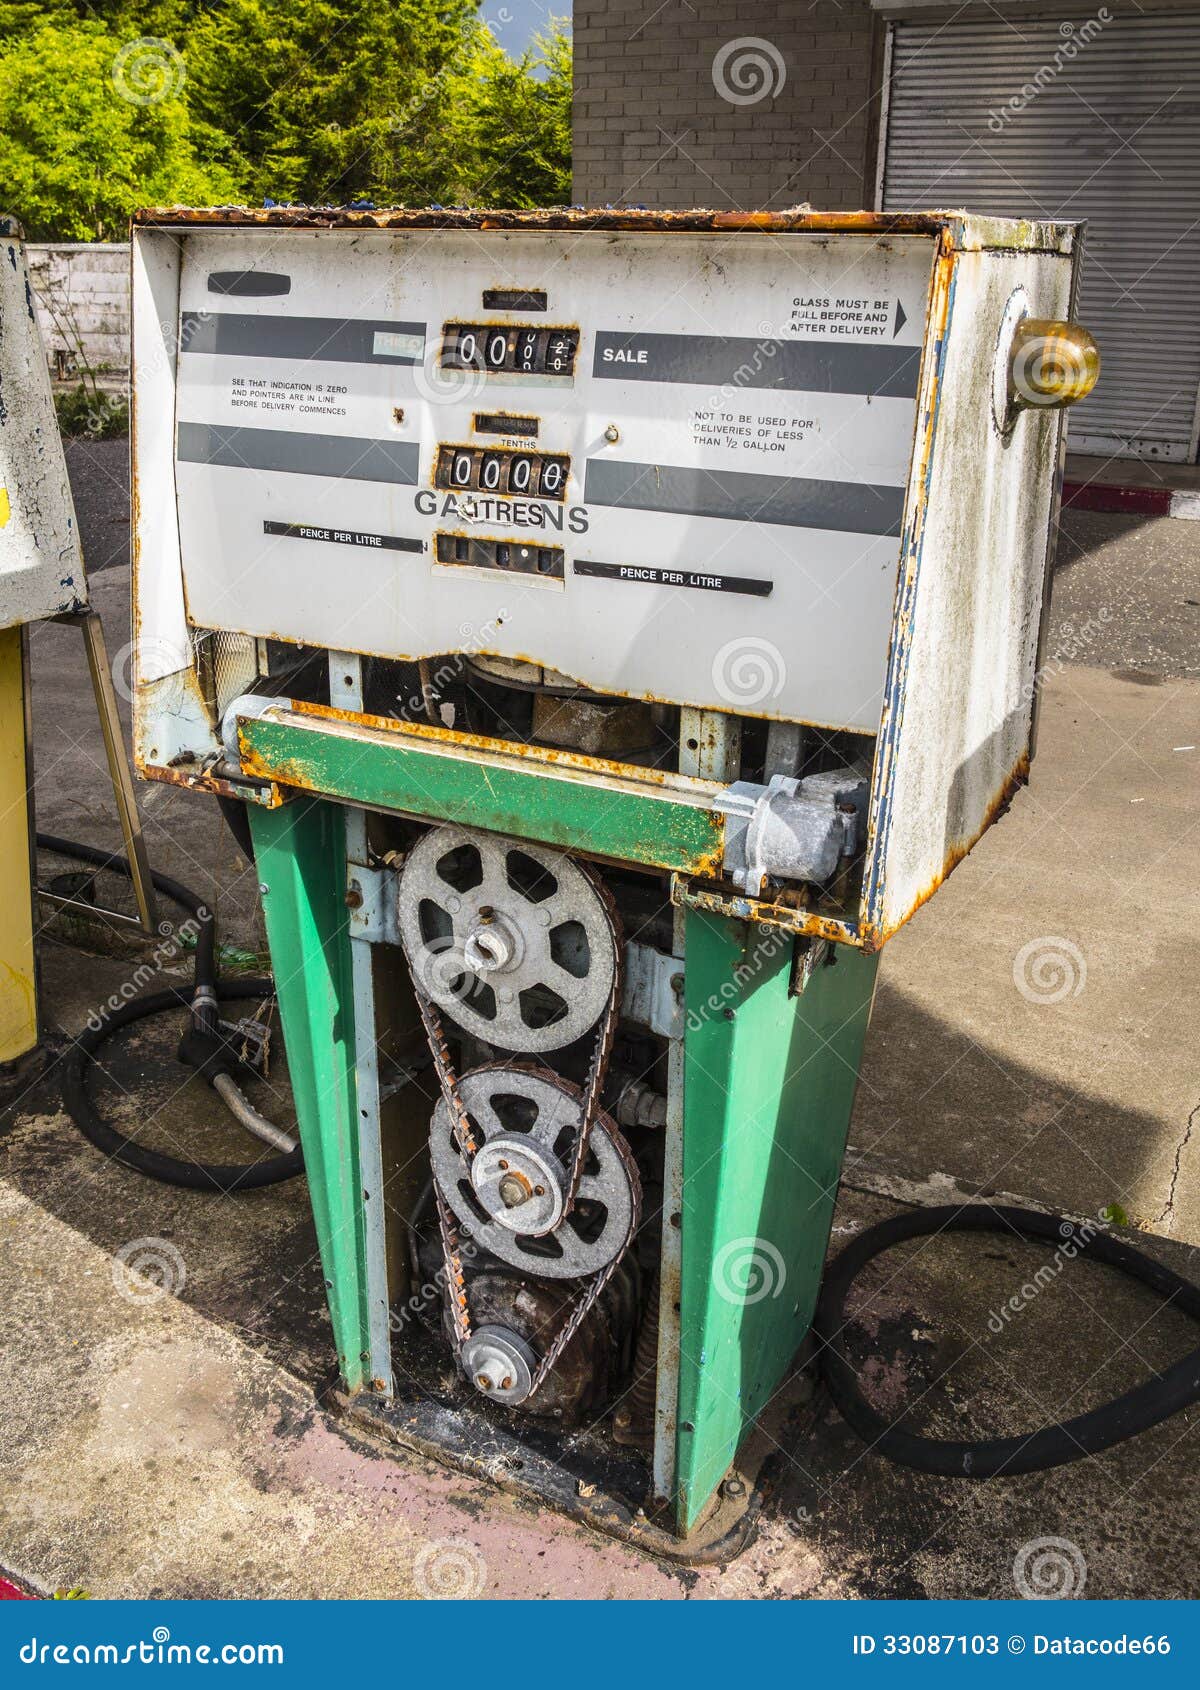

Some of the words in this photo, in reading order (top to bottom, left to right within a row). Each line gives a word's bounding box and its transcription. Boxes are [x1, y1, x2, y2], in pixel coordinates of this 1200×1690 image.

[793, 298, 829, 307] GLASS
[836, 299, 868, 309] MUST
[874, 301, 889, 309] BE
[791, 310, 818, 320] FULL
[820, 312, 863, 321] BEFORE
[864, 314, 888, 322] AND
[791, 323, 826, 332] AFTER
[830, 325, 886, 335] DELIVERY
[602, 348, 648, 364] SALE
[232, 378, 245, 386] SEE
[249, 379, 266, 388] THAT
[270, 381, 312, 391] INDICATION
[327, 385, 347, 394] ZERO
[250, 390, 286, 399] POINTERS
[289, 393, 304, 401] ARE
[307, 394, 315, 402] IN
[318, 396, 335, 404] LINE
[231, 399, 258, 408] BEFORE
[262, 402, 295, 411] DELIVERY
[299, 405, 346, 415] COMMENCES
[695, 411, 715, 420] NOT
[720, 413, 733, 422] TO
[739, 415, 752, 423] BE
[758, 416, 786, 427] USED
[791, 419, 814, 429] FOR
[694, 423, 752, 436] DELIVERIES
[757, 428, 772, 437] OF
[777, 430, 804, 440] LESS
[501, 439, 537, 449] TENTHS
[693, 436, 720, 446] THAN
[743, 440, 785, 451] GALLON
[300, 527, 330, 540] PENCE
[334, 533, 352, 542] PER
[356, 535, 382, 546] LITRE
[620, 567, 657, 580] PENCE
[662, 572, 684, 583] PER
[690, 575, 722, 588] LITRE
